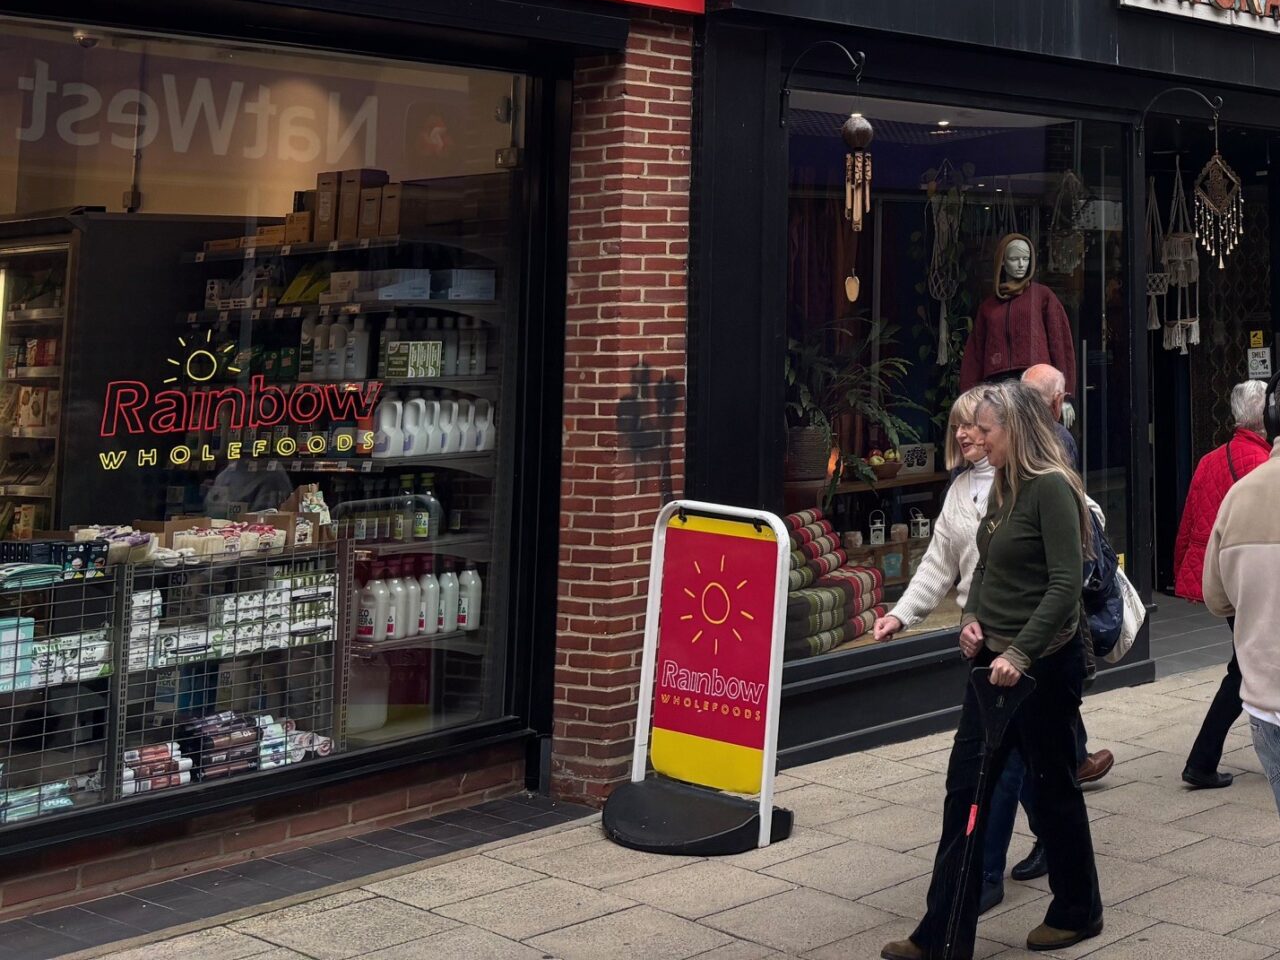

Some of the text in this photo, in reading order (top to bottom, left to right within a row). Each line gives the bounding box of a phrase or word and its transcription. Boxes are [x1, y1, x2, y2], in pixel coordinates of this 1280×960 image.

[100, 375, 383, 437] Rainbow
[100, 431, 374, 470] WHOLEFOODS
[662, 660, 765, 704] Rainbow
[661, 693, 761, 721] WHOLEFOODS
